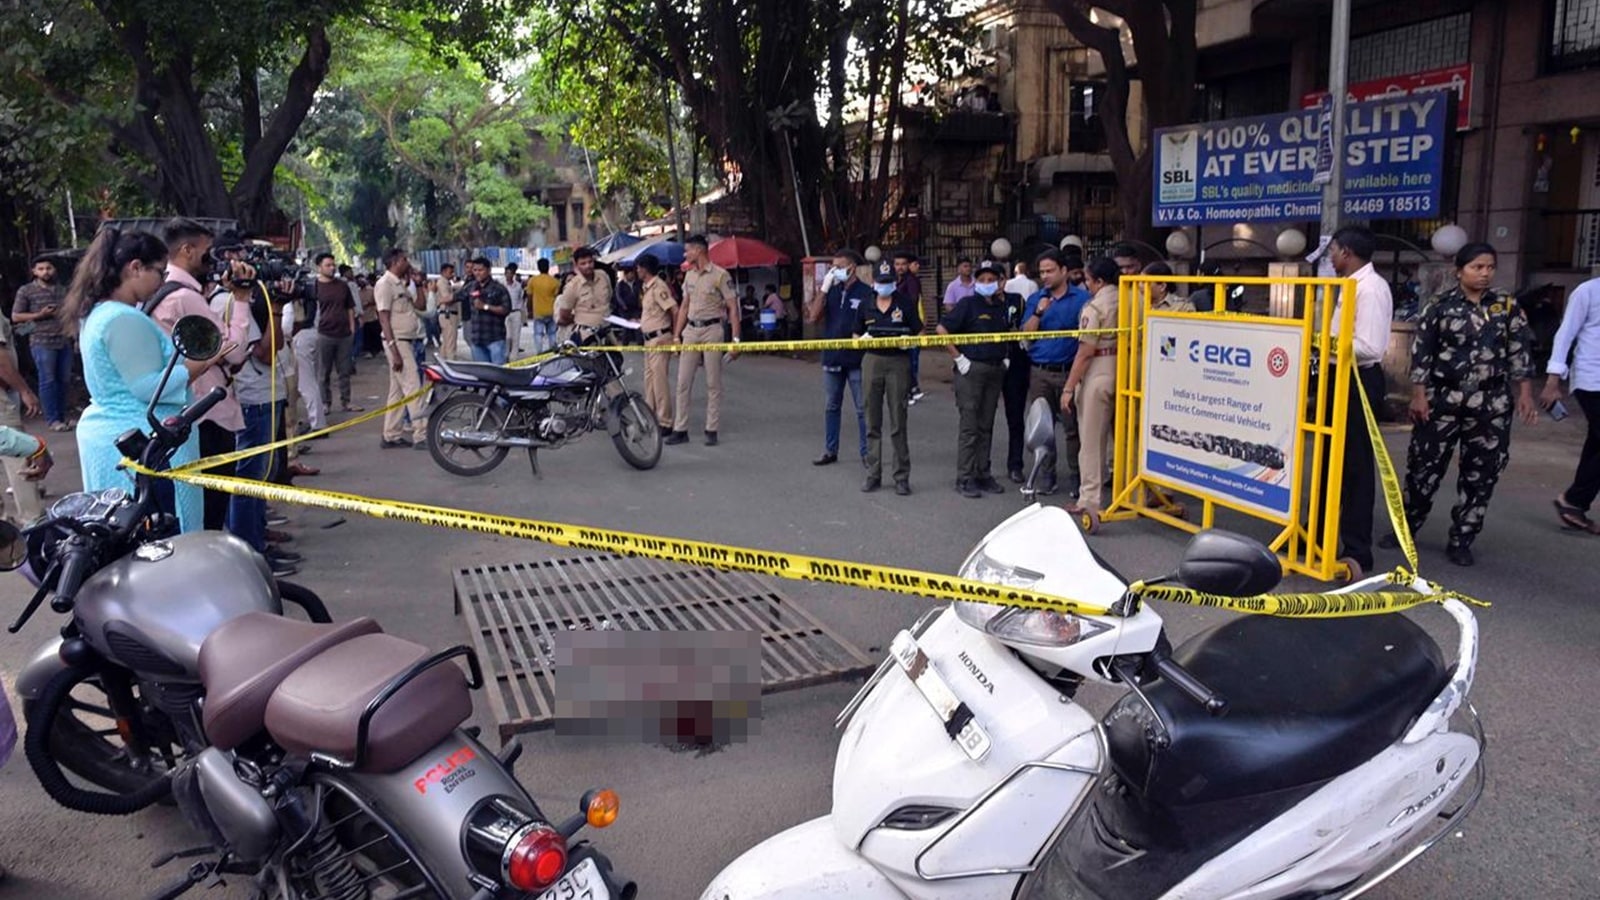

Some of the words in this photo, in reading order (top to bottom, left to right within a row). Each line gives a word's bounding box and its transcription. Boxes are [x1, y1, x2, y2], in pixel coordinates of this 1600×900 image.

[1203, 122, 1270, 150] 100%
[1280, 99, 1436, 144] QULITY
[1203, 154, 1236, 178] AT
[1243, 146, 1317, 175] EVER
[1346, 134, 1433, 166] STEP
[1163, 170, 1193, 184] SBL
[1202, 185, 1228, 199] SBL's
[1231, 183, 1264, 202] quality
[1344, 173, 1399, 189] available
[1402, 172, 1432, 186] here
[1206, 204, 1281, 221] Homoeopathic
[1284, 202, 1321, 216] Chemi
[1344, 198, 1384, 214] 84469
[1388, 195, 1431, 212] 18513
[1204, 344, 1251, 367] eka
[1173, 388, 1196, 400] India's
[1197, 393, 1226, 407] Largest
[1226, 397, 1251, 412] Range
[1253, 402, 1263, 412] of
[1164, 400, 1191, 414] Electric
[1191, 406, 1236, 424] Commercial
[1236, 416, 1271, 431] Vehicles
[958, 651, 995, 695] HONDA
